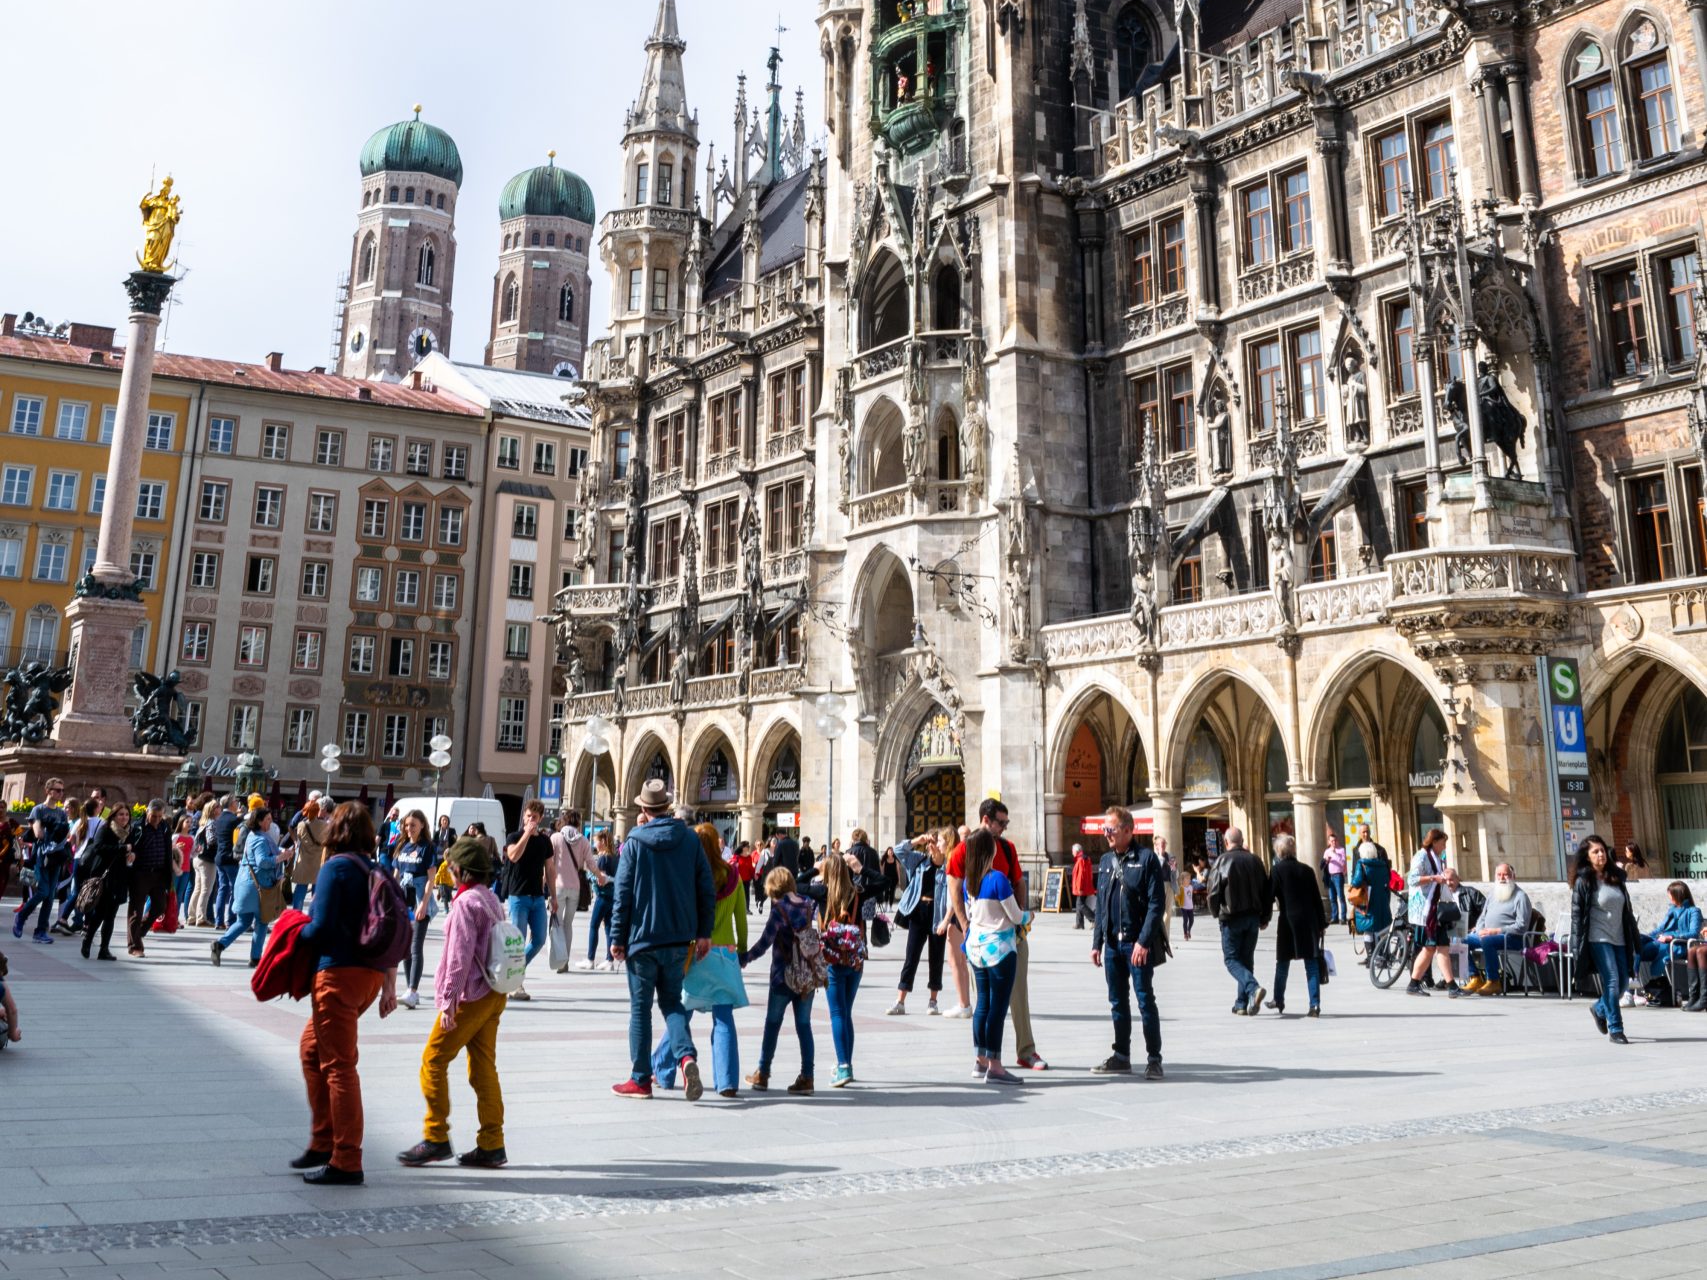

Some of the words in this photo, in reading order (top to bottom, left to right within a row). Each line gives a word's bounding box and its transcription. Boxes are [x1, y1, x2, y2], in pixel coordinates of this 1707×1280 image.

[1554, 664, 1574, 699] S
[1558, 710, 1578, 746] U
[545, 757, 558, 775] S
[1559, 760, 1587, 769] Marienplatz
[544, 779, 556, 796] U
[769, 770, 797, 789] Linda
[1567, 781, 1584, 791] 15:30
[766, 791, 800, 801] ARSCHMUC
[1672, 851, 1707, 863] Stadt-
